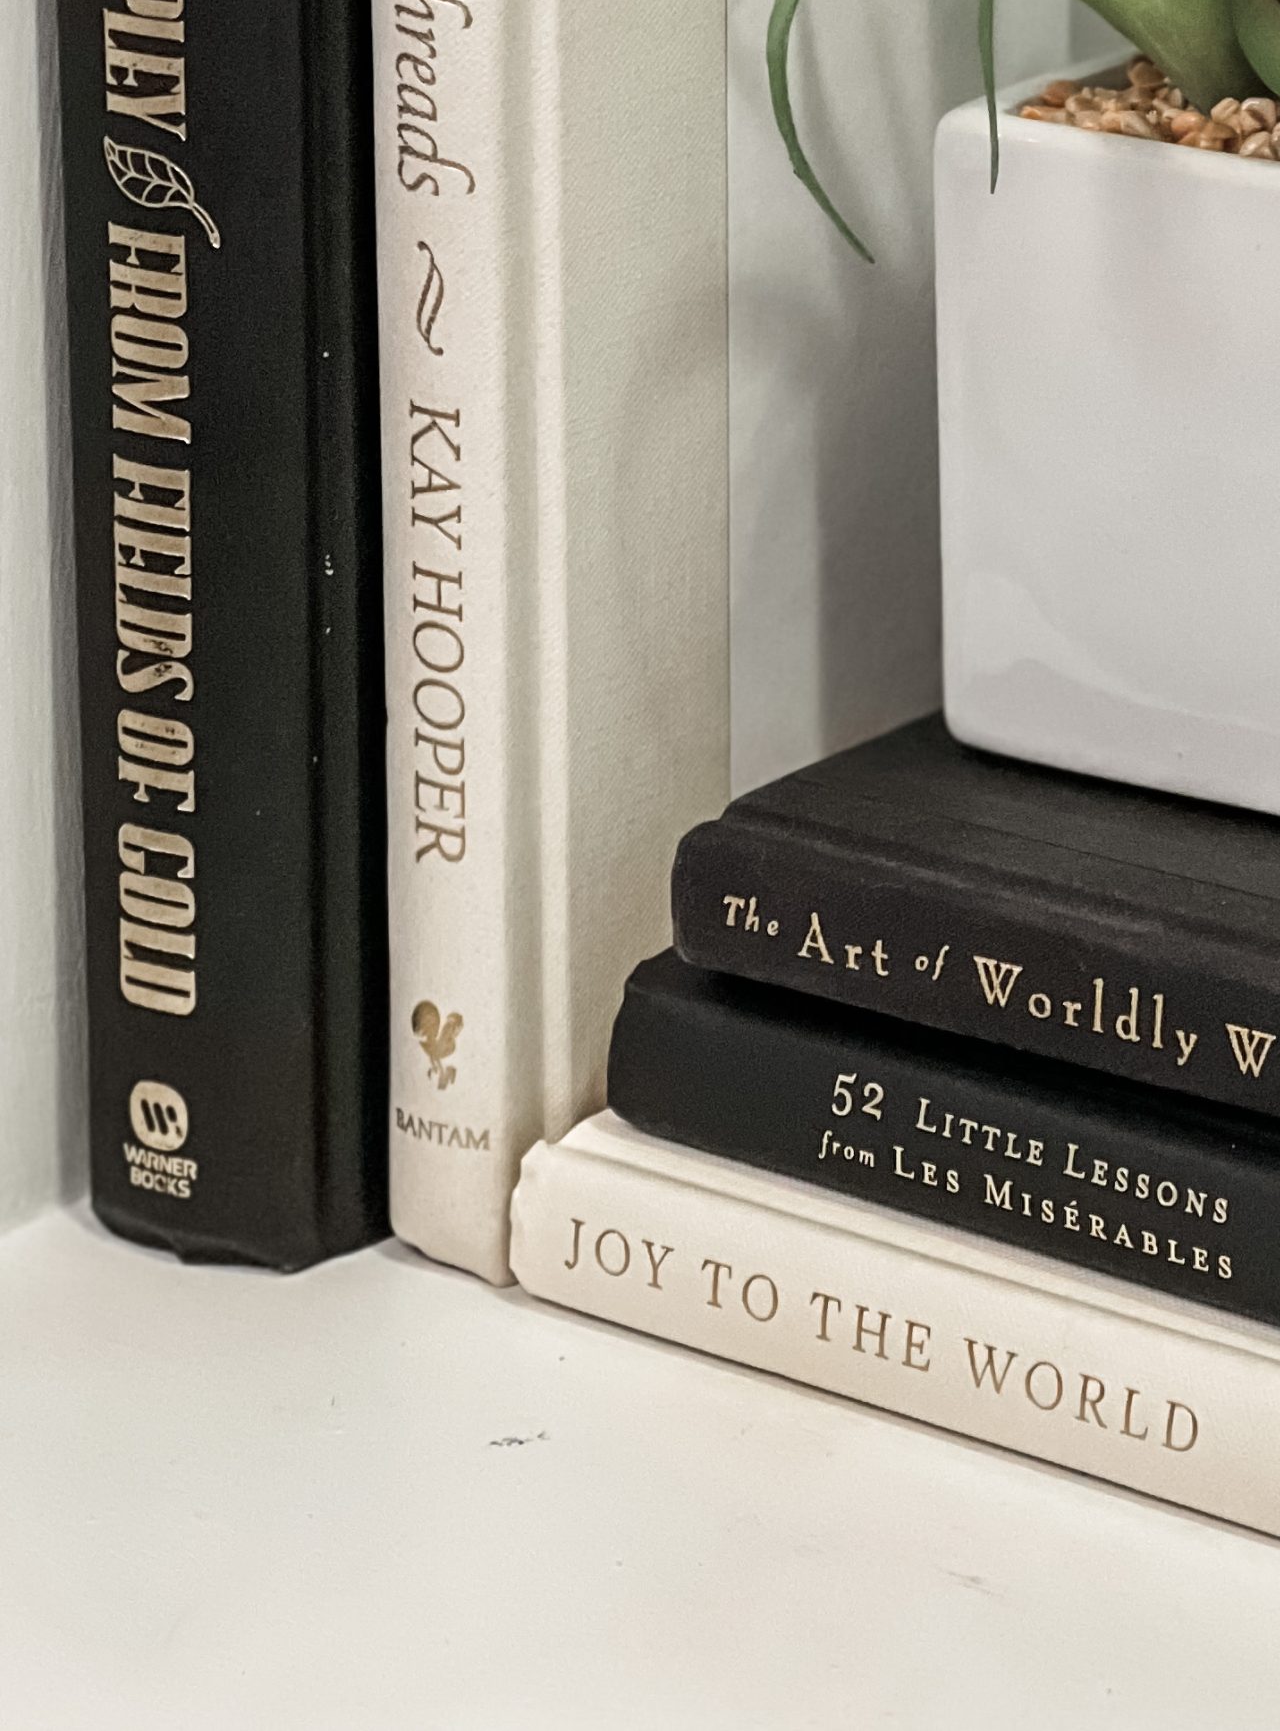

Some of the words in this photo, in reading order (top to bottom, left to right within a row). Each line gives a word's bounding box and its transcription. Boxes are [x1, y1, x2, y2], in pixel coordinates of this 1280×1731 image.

[108, 221, 192, 444] FROM
[410, 398, 462, 550] KAY
[113, 453, 195, 701] FIELDS
[117, 708, 195, 812] OF
[412, 561, 467, 864] HOOPER
[118, 823, 196, 1015] GOLD
[722, 895, 780, 938] The
[797, 912, 890, 977] Art
[913, 945, 950, 981] of
[973, 955, 1198, 1066] Worldly
[123, 1142, 198, 1181] WARNER
[395, 1107, 490, 1151] BANTAM
[818, 1130, 875, 1168] from
[892, 1146, 960, 1194] LES
[830, 1073, 885, 1120] 52
[130, 1165, 191, 1198] BOOKS
[563, 1218, 676, 1291] JOY
[701, 1258, 779, 1323] TO
[809, 1292, 933, 1372] THE
[963, 1336, 1201, 1453] WORLD
